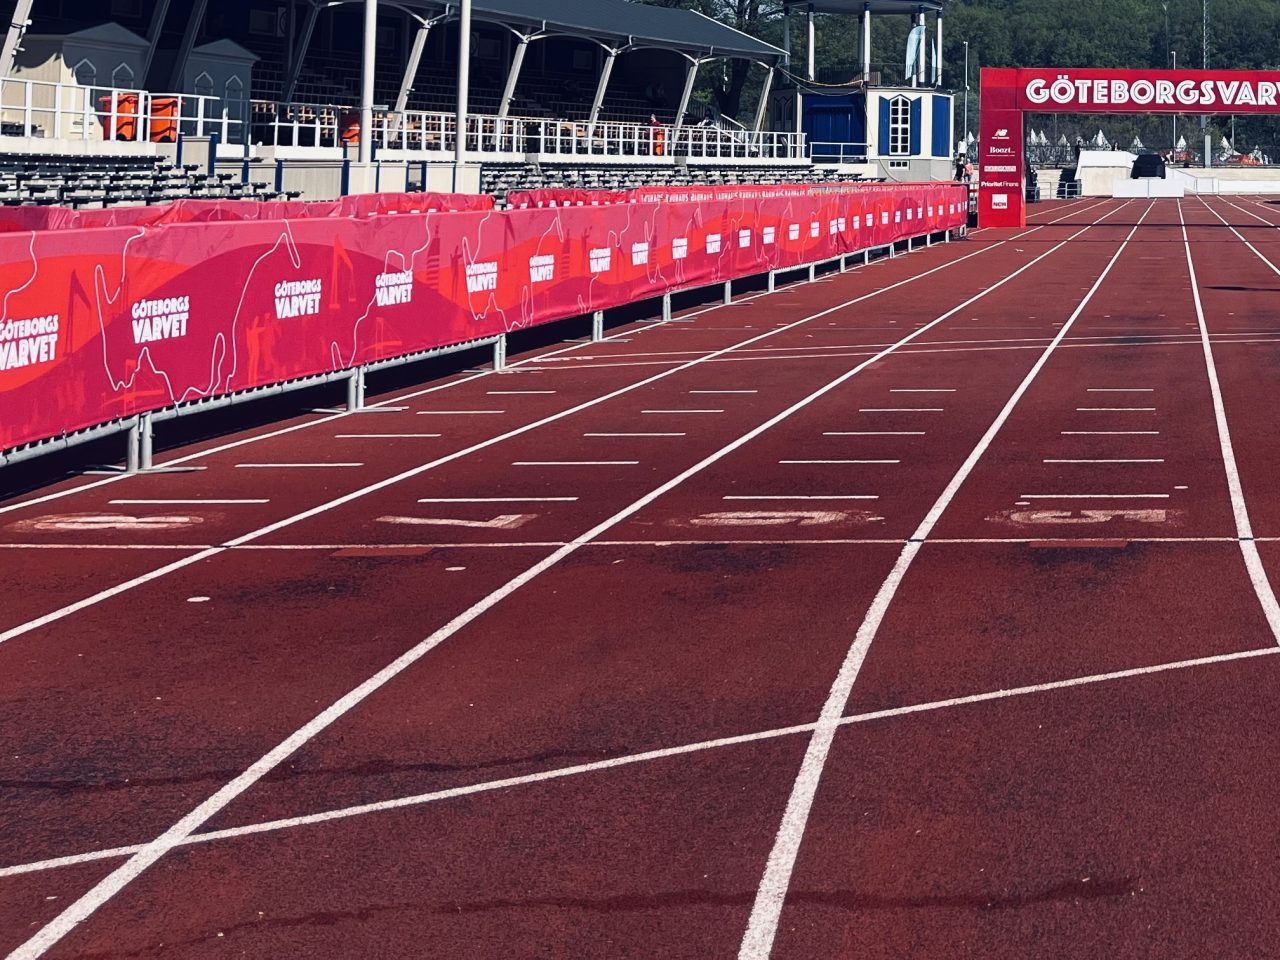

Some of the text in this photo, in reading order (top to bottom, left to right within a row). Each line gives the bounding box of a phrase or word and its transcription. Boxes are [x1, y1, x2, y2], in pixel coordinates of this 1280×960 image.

[275, 278, 322, 297] GÖTEBORGS
[375, 283, 413, 307] VARVET
[131, 295, 190, 319] GÖTEBORGS
[275, 293, 321, 319] VARVET
[132, 312, 189, 344] VARVET
